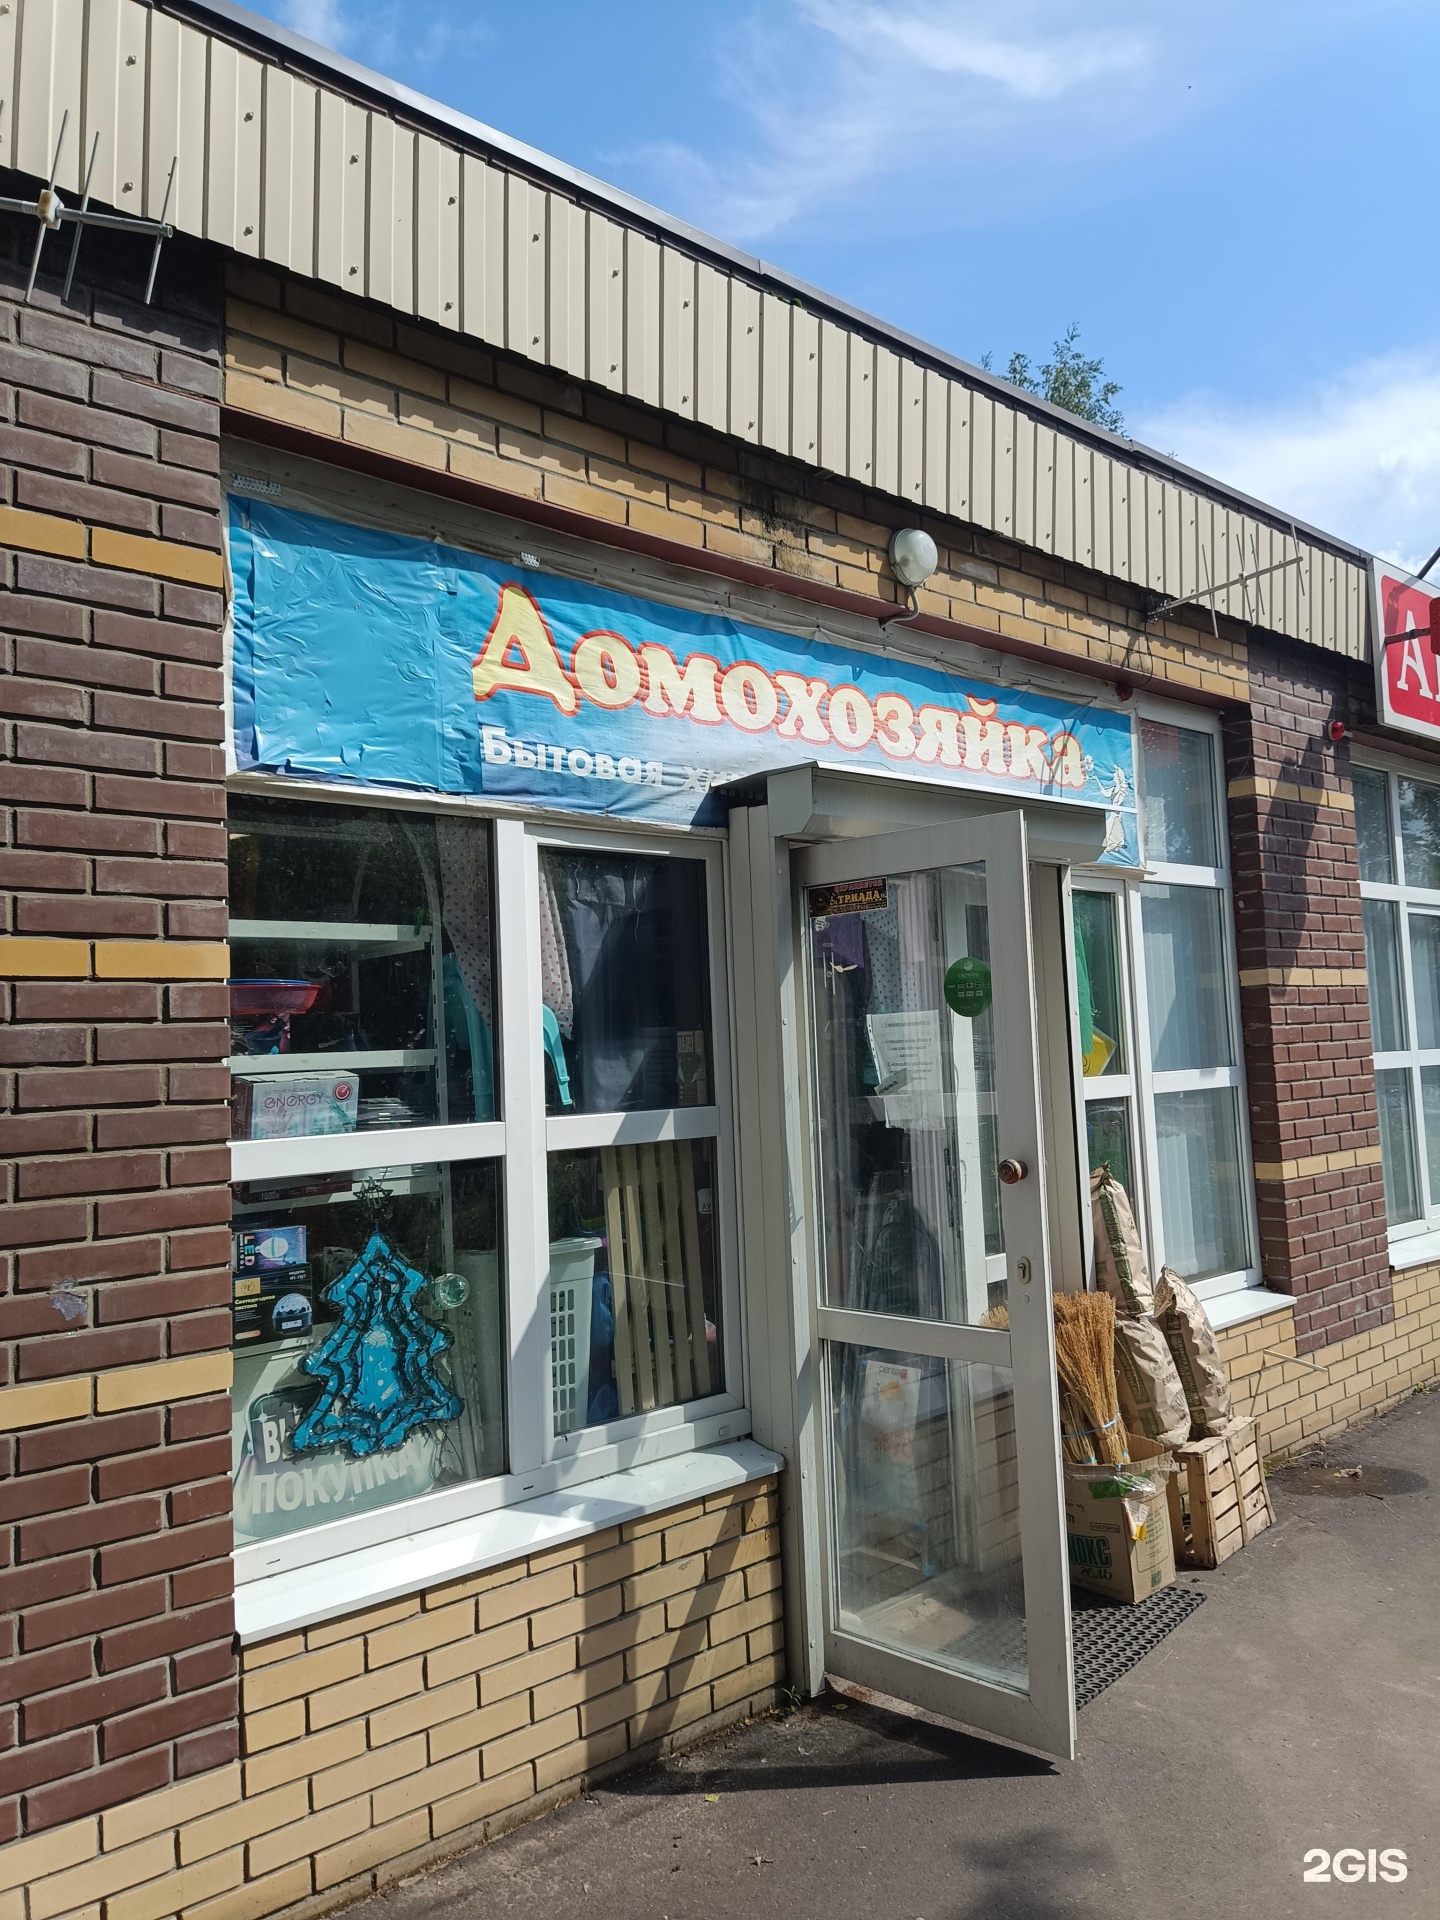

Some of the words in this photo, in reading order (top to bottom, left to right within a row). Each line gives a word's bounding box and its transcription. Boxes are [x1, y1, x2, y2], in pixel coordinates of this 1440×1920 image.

[472, 580, 1087, 790] Домохозяйка
[481, 725, 663, 786] Бытовая
[244, 1234, 256, 1267] LED
